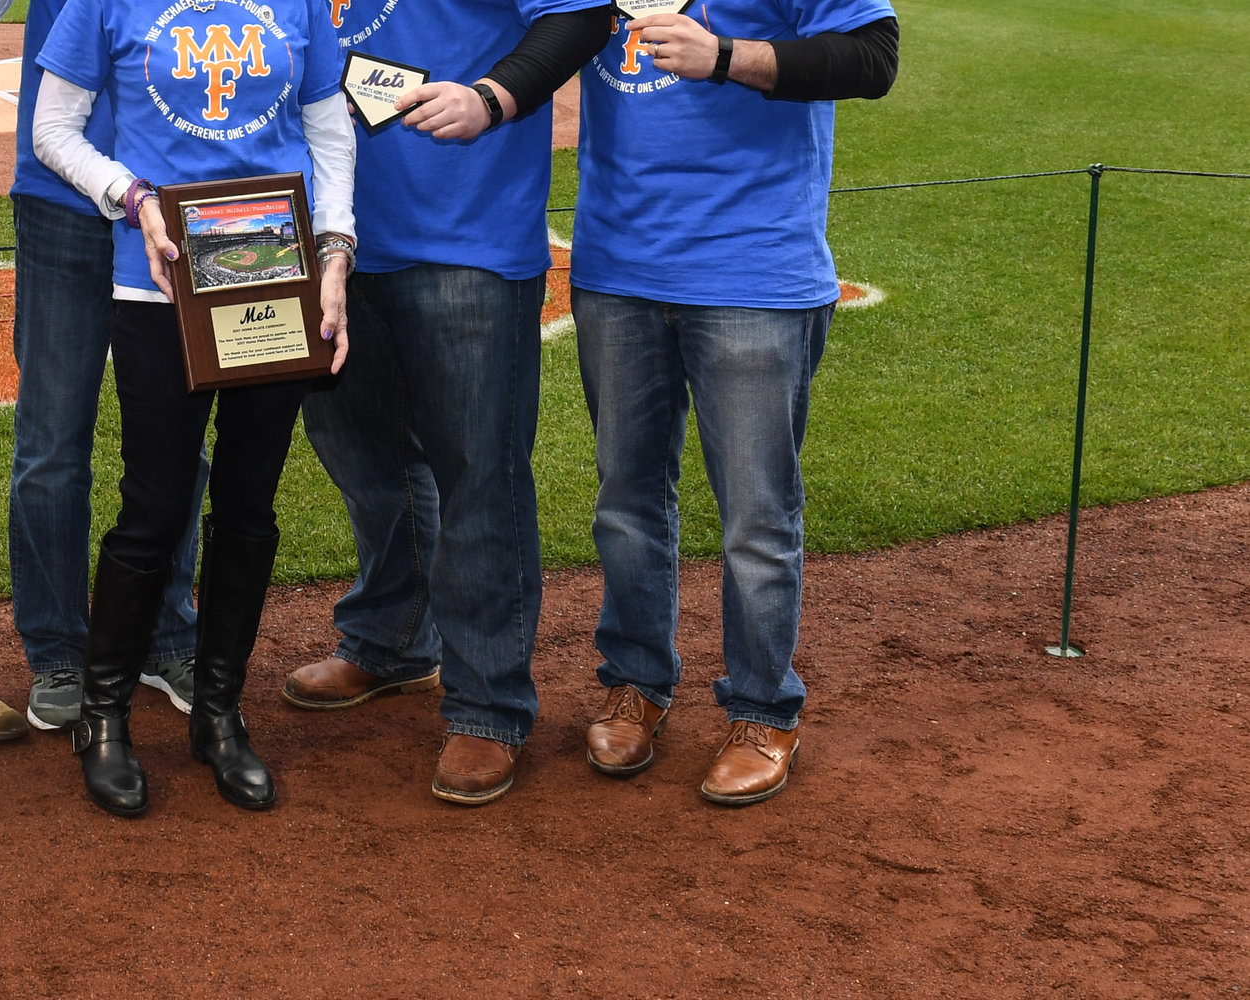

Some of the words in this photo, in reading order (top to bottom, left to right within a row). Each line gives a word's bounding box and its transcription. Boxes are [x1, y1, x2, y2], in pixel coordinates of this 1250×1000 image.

[145, 24, 162, 43] THE
[353, 26, 372, 45] CHILD
[361, 68, 405, 89] Mets
[598, 69, 635, 94] DIFFERENCE
[638, 83, 654, 94] ONE
[146, 84, 168, 116] MAKING
[174, 118, 226, 141] DIFFERENCE
[227, 129, 244, 141] ONE
[245, 115, 268, 134] CHILD
[277, 81, 292, 104] TIME
[240, 304, 276, 325] Mets
